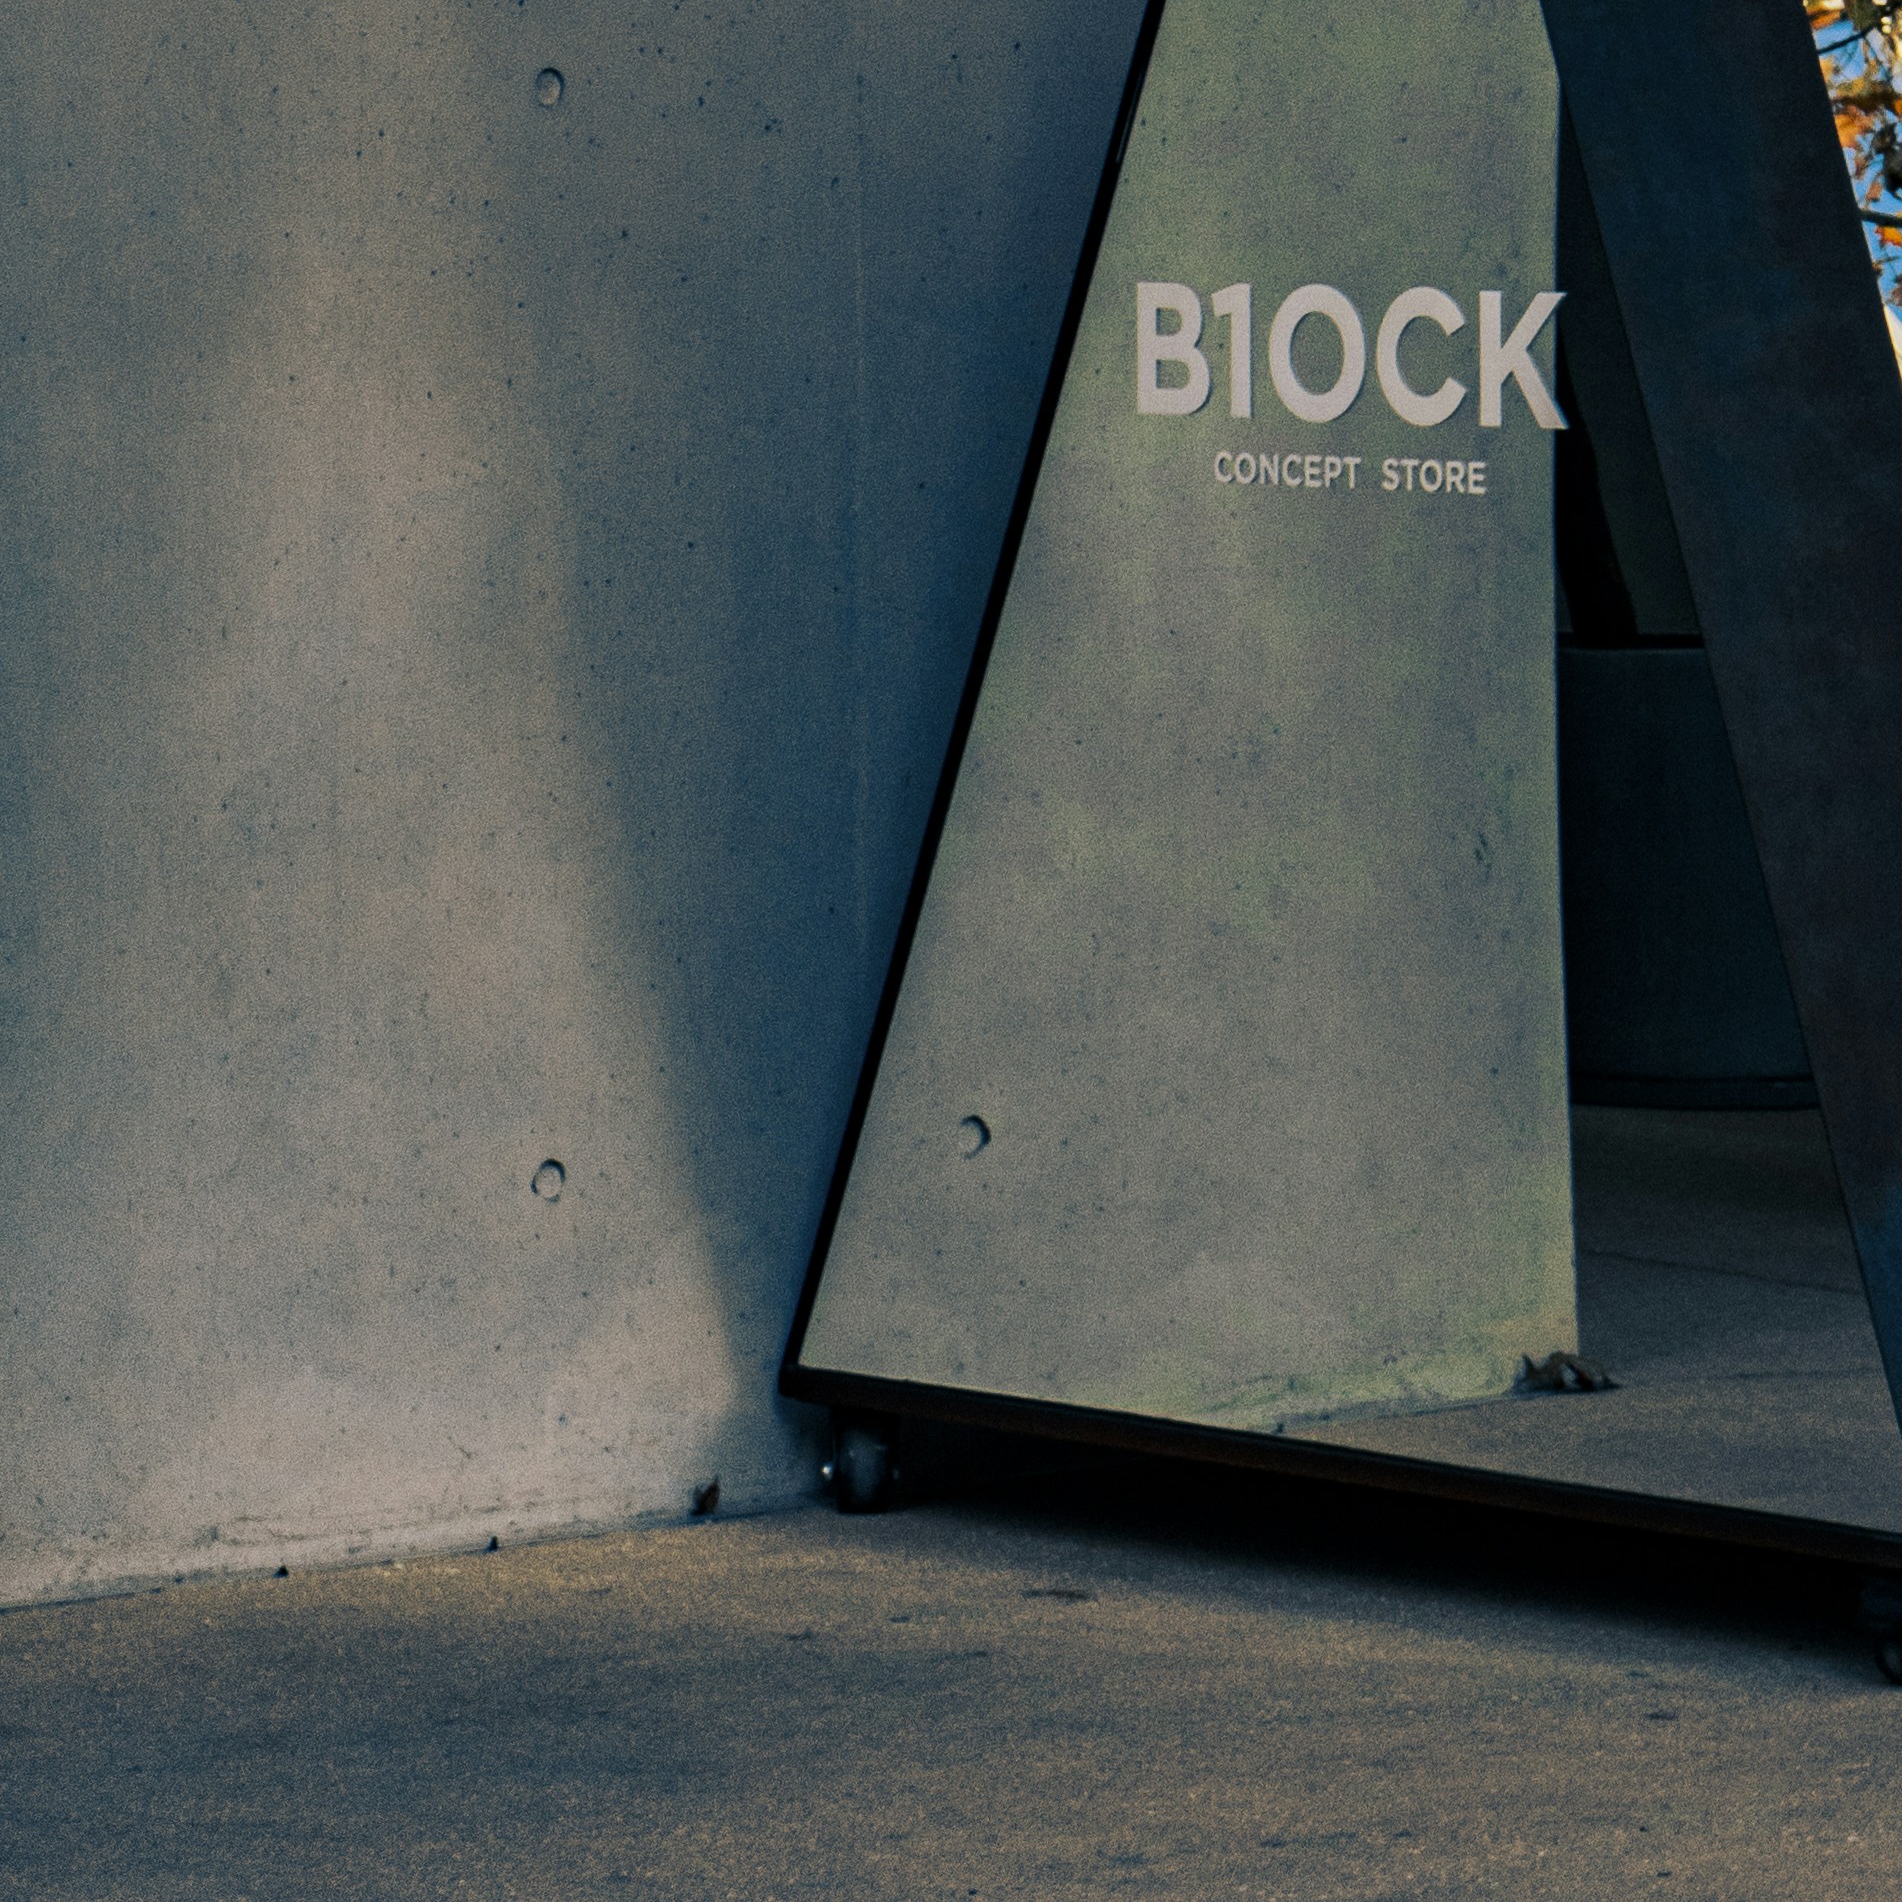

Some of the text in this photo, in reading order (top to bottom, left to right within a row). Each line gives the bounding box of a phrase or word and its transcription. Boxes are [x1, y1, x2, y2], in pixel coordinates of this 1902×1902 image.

[1136, 281, 1569, 431] B1OCK
[1213, 451, 1487, 495] CONCEPT STORE
